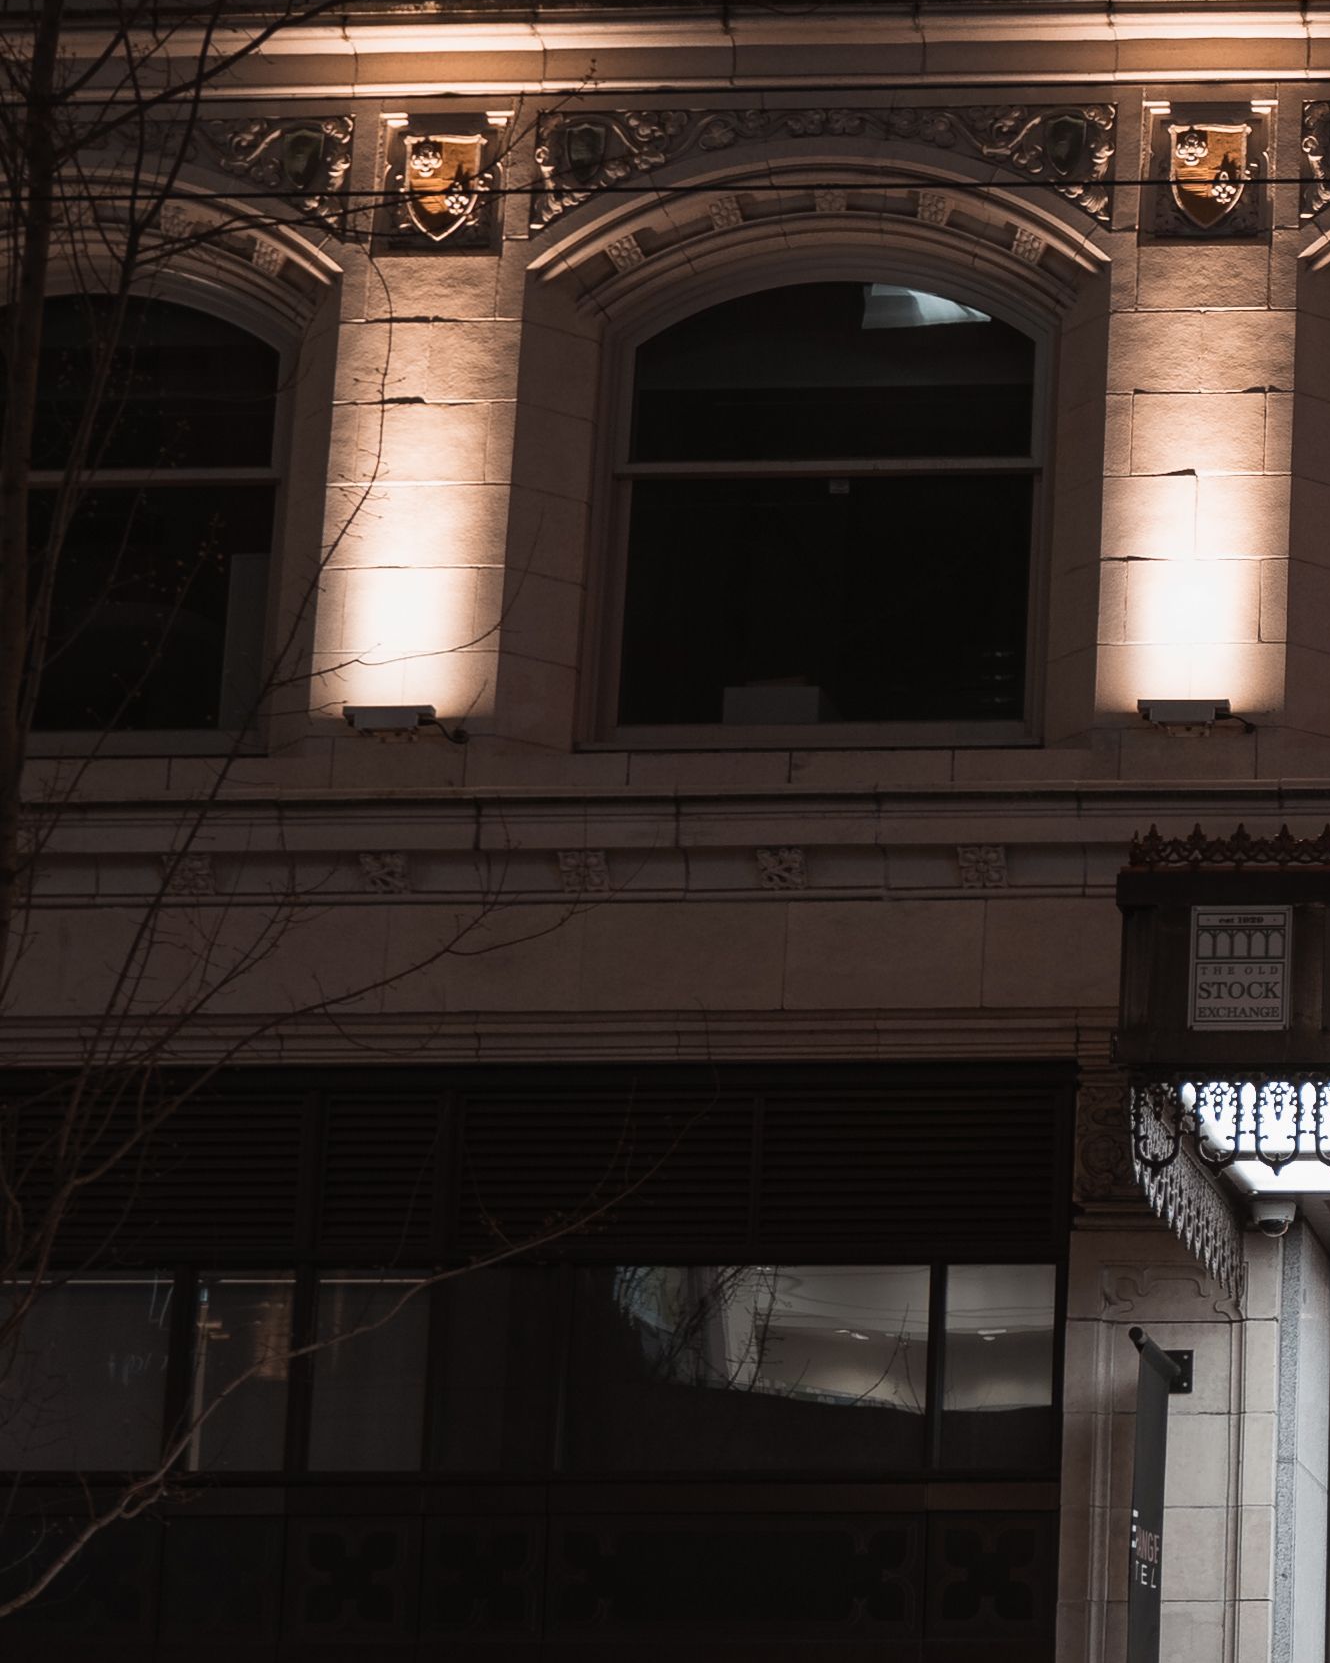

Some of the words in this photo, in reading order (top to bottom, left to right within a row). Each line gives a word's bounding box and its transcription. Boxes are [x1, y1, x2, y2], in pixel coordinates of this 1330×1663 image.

[1200, 966, 1235, 975] THE
[1245, 966, 1278, 975] OLD
[1198, 981, 1280, 999] STOCK
[1198, 1007, 1280, 1017] EXCHANGE
